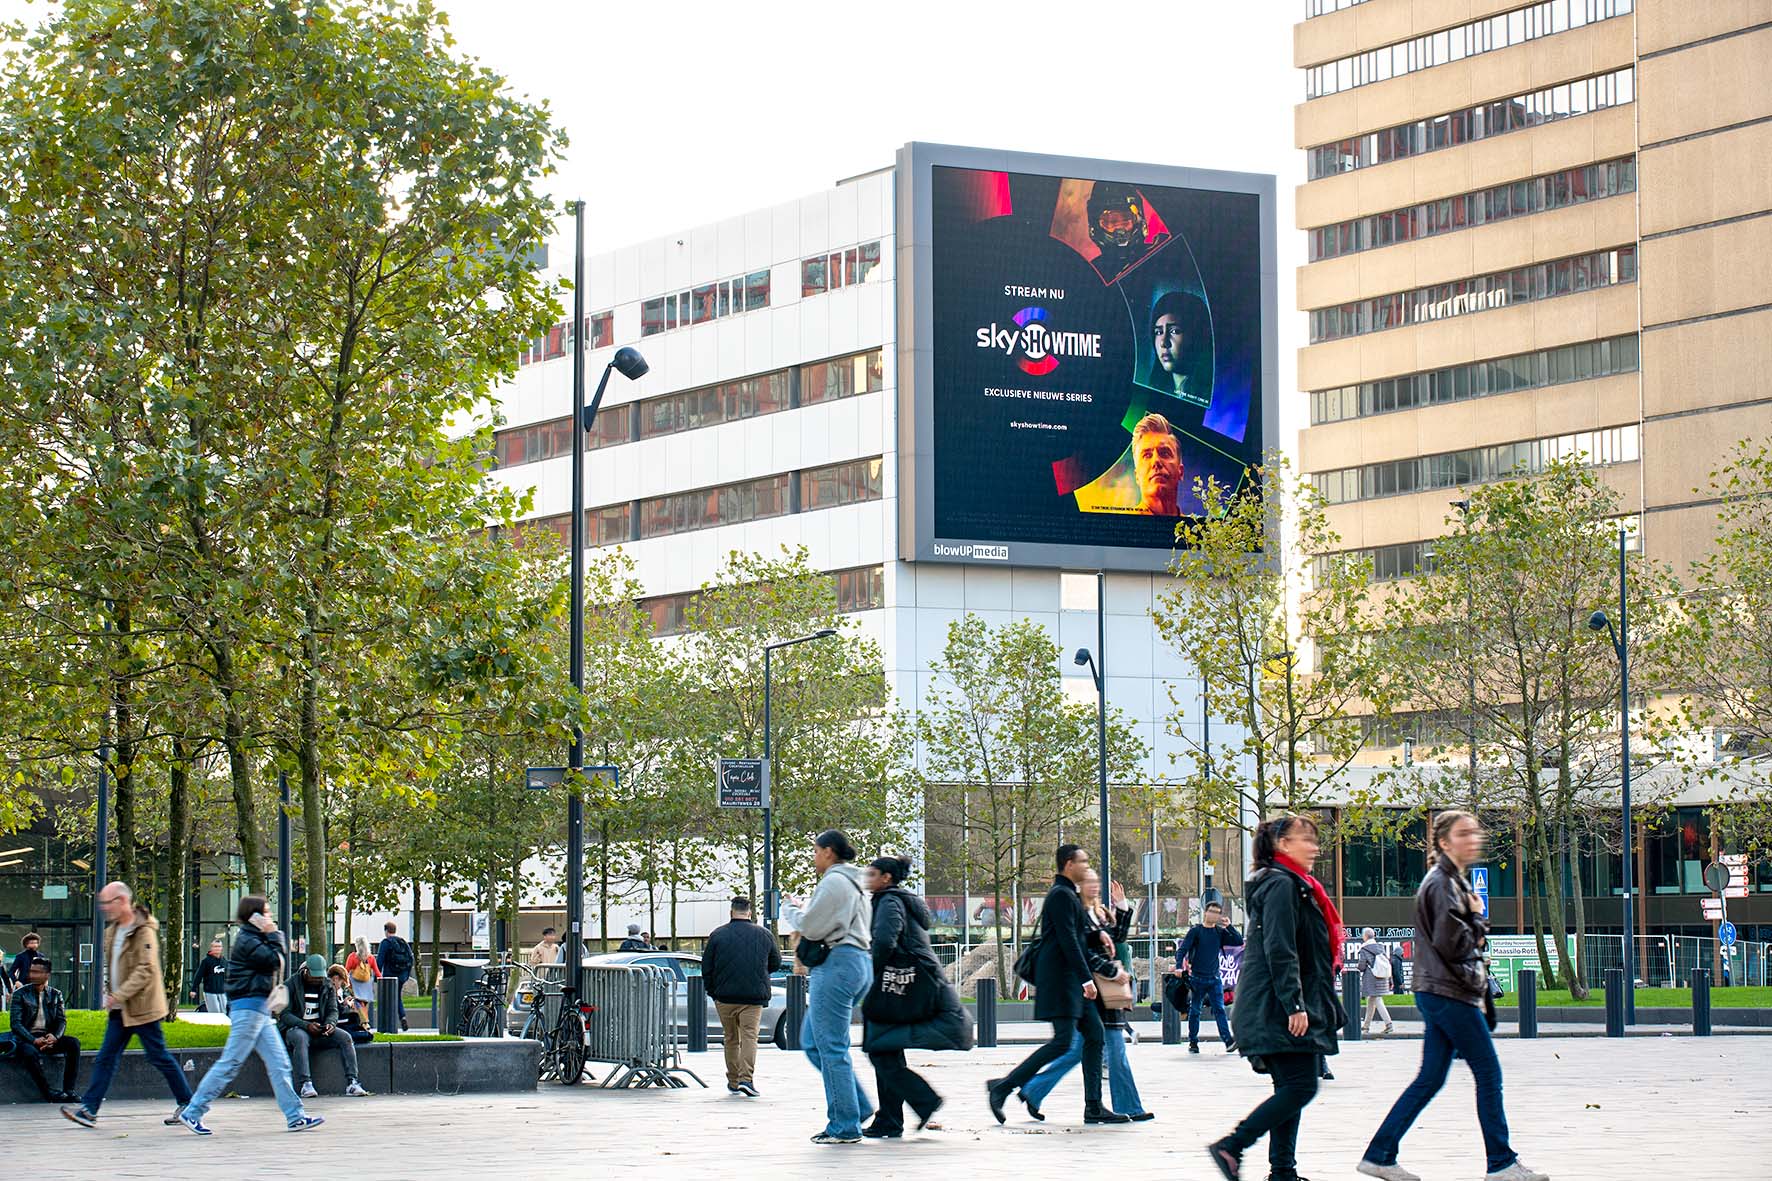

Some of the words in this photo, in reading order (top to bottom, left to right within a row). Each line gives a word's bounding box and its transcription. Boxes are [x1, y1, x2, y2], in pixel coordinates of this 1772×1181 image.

[1004, 285, 1047, 298] STREAM
[1049, 289, 1065, 300] NU
[984, 387, 1032, 399] EXCLUSIEVE
[1033, 391, 1065, 401] NIEUWE
[1065, 393, 1093, 403] SERIES
[1010, 420, 1068, 431] skyshowtime.com
